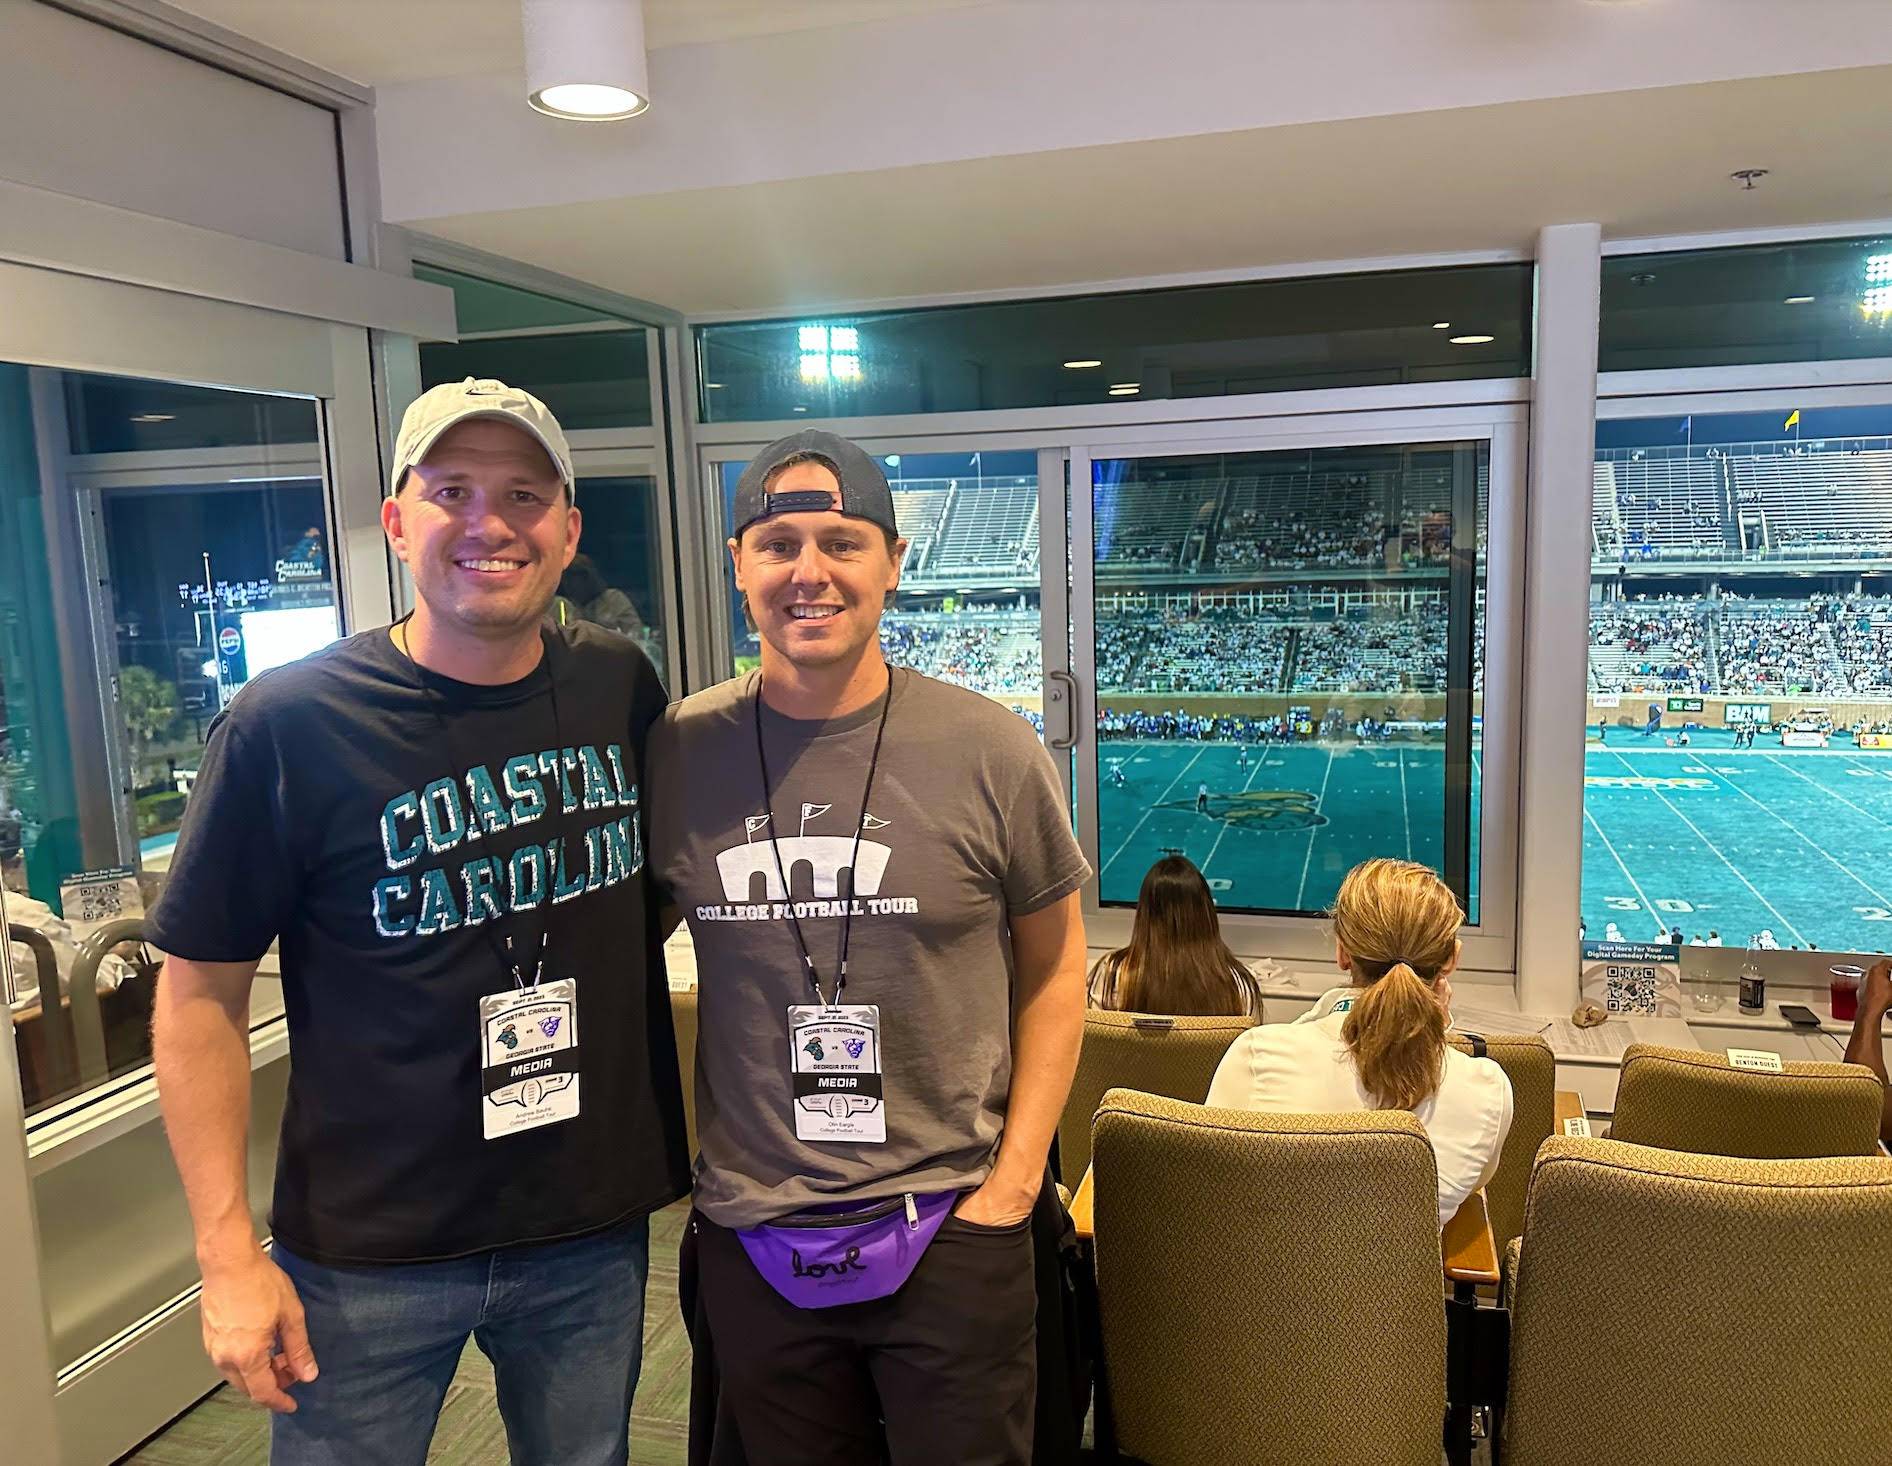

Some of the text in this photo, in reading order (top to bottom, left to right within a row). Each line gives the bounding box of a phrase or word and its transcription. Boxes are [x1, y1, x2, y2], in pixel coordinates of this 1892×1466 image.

[380, 744, 640, 871] COASTAL
[696, 903, 769, 921] COLLEGE
[868, 897, 919, 916] TOUR
[1587, 951, 1675, 961] Digital Gameday Program
[497, 1007, 561, 1026] COASTAL CAROLINA
[804, 1028, 865, 1036] COASTAL CAROLINA
[506, 1043, 555, 1059] GEORGIA STATE
[510, 1058, 553, 1077] MEDIA
[818, 1077, 858, 1088] MEDIA
[791, 1246, 867, 1278] love
